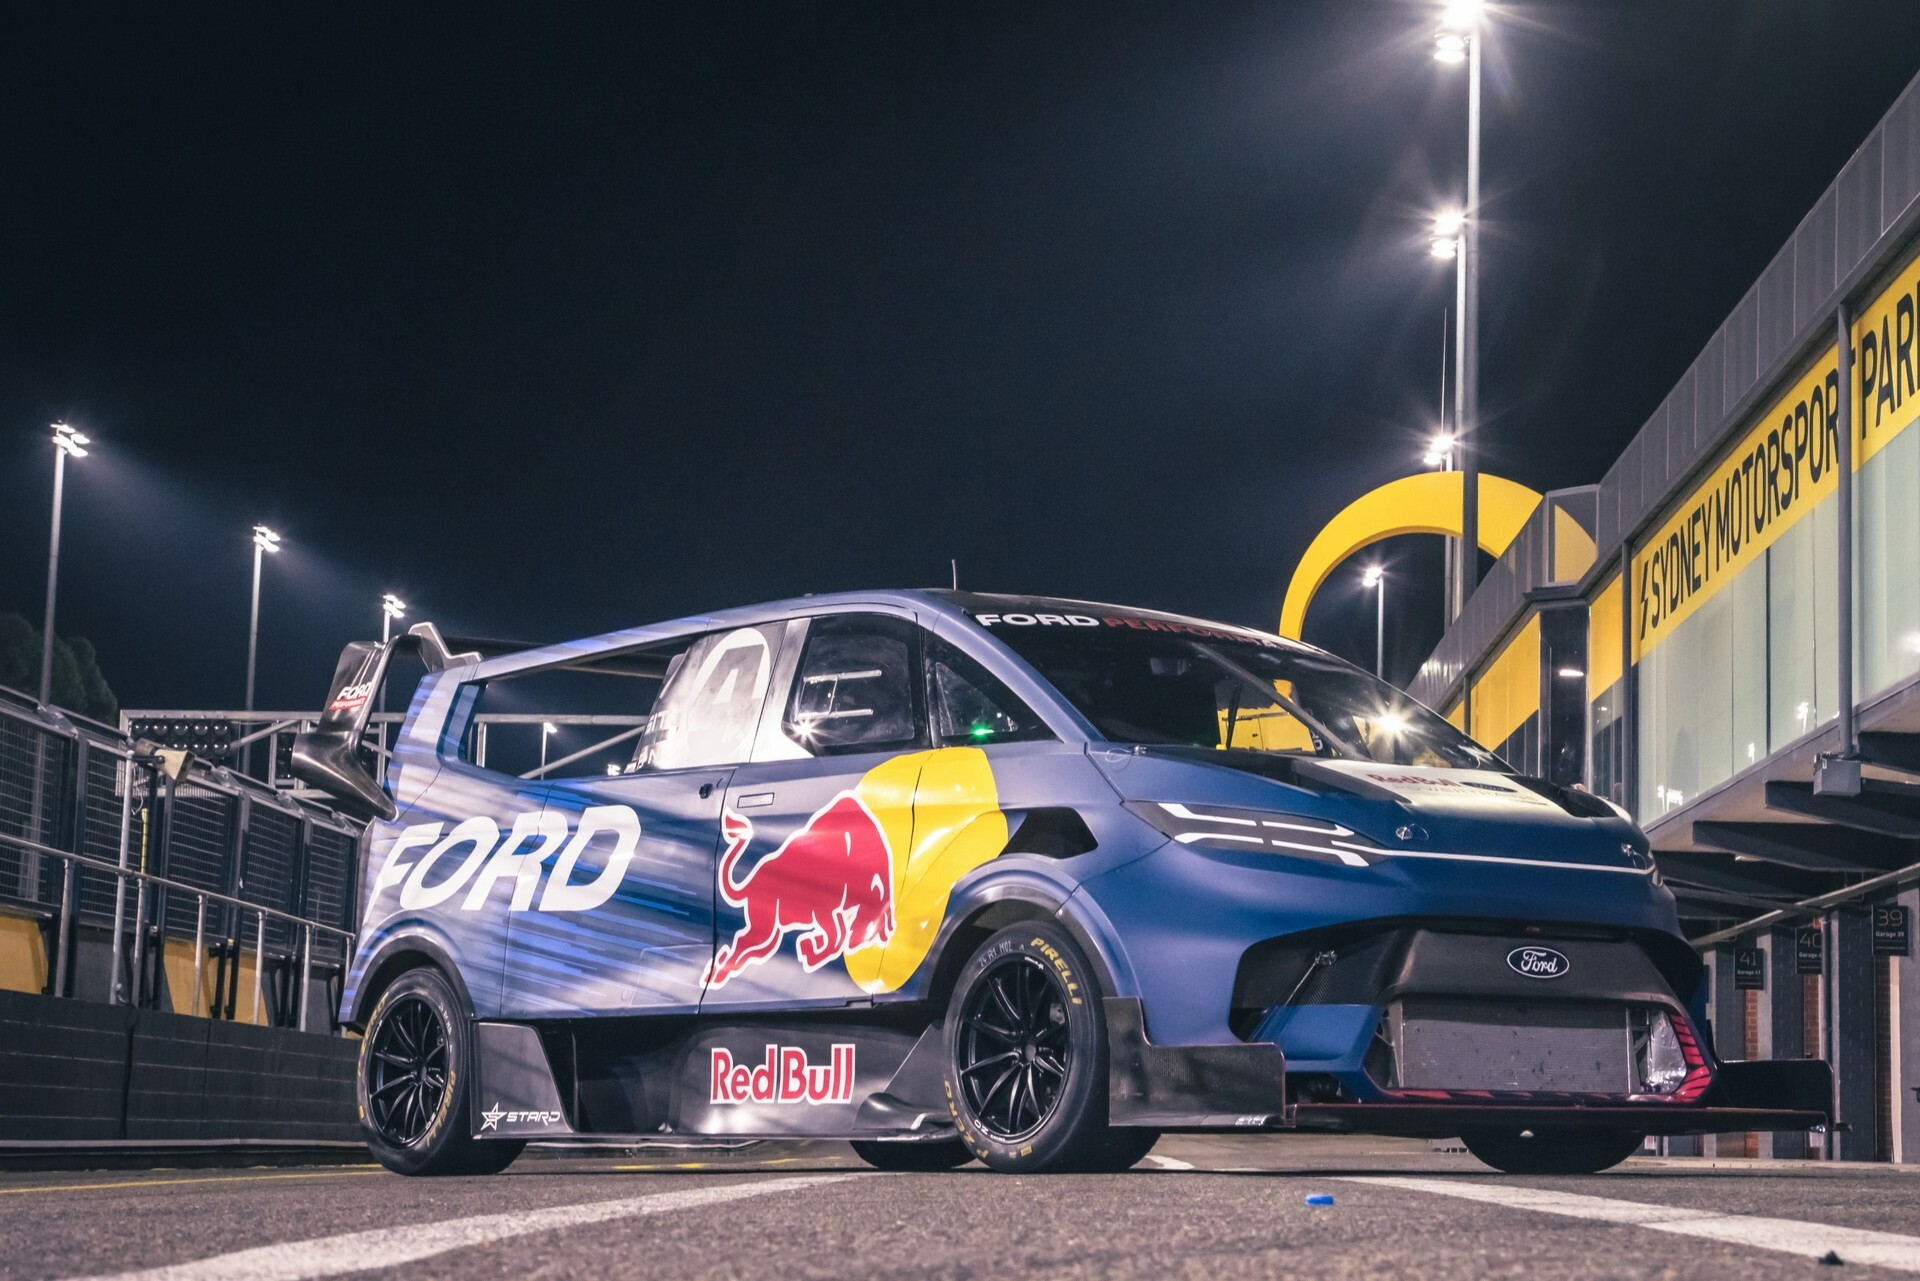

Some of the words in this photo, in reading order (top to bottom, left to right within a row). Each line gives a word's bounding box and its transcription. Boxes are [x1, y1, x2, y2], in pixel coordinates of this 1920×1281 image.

[1652, 494, 1713, 629] SYDNEY
[1715, 347, 1856, 573] MOTORSPOR
[976, 613, 1100, 627] FORD
[336, 682, 373, 700] FORD
[363, 805, 641, 926] FORD
[1877, 909, 1903, 927] 39
[1521, 950, 1558, 973] Ford
[1739, 951, 1757, 966] 41
[1798, 952, 1817, 960] Garage
[1030, 937, 1083, 1005] PIRELLI
[711, 1044, 777, 1104] Red
[778, 1044, 855, 1105] Bull
[506, 1111, 561, 1127] STARD
